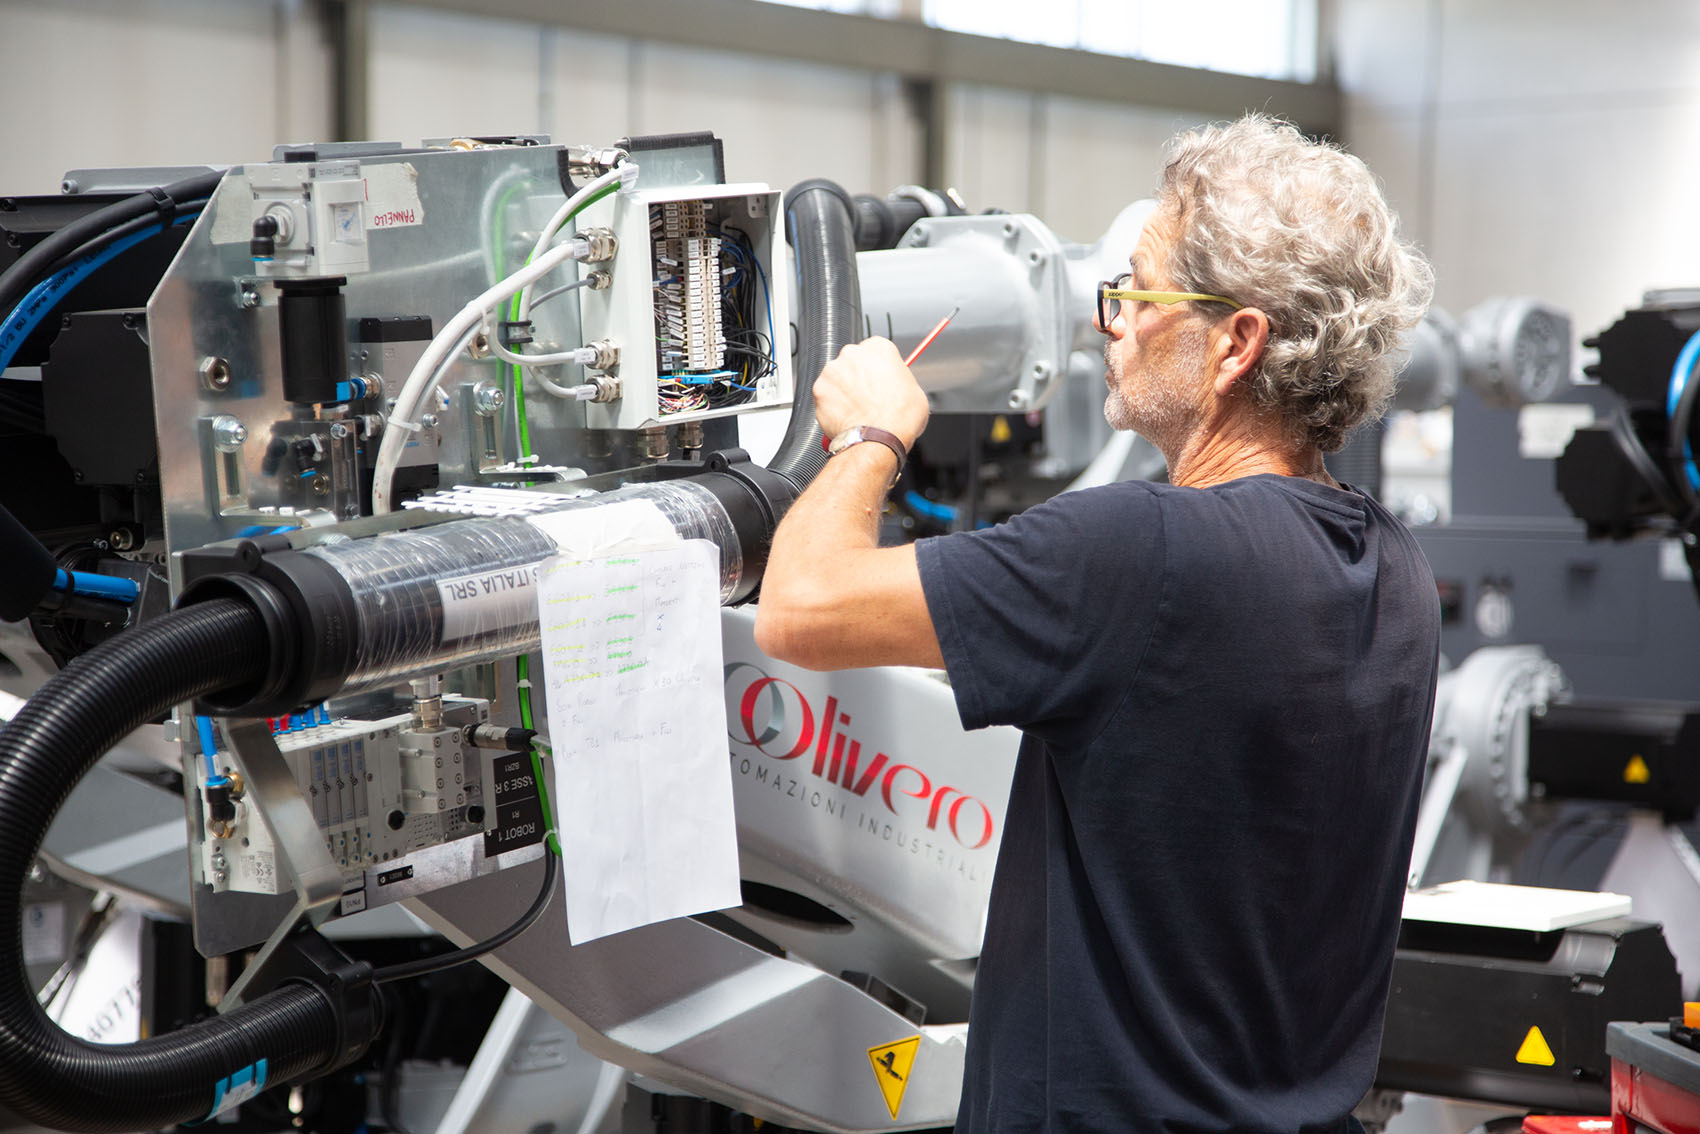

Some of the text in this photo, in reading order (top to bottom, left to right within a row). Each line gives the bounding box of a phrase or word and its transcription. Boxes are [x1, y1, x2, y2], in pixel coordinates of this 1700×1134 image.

[374, 208, 415, 226] PANNELLO
[444, 580, 478, 600] SRL
[479, 568, 530, 594] ITALIA
[740, 676, 994, 850] Olivero
[503, 780, 510, 792] 3
[730, 751, 846, 820] TOMAZIONI
[511, 810, 520, 819] R1
[498, 822, 536, 842] ROBOT 1
